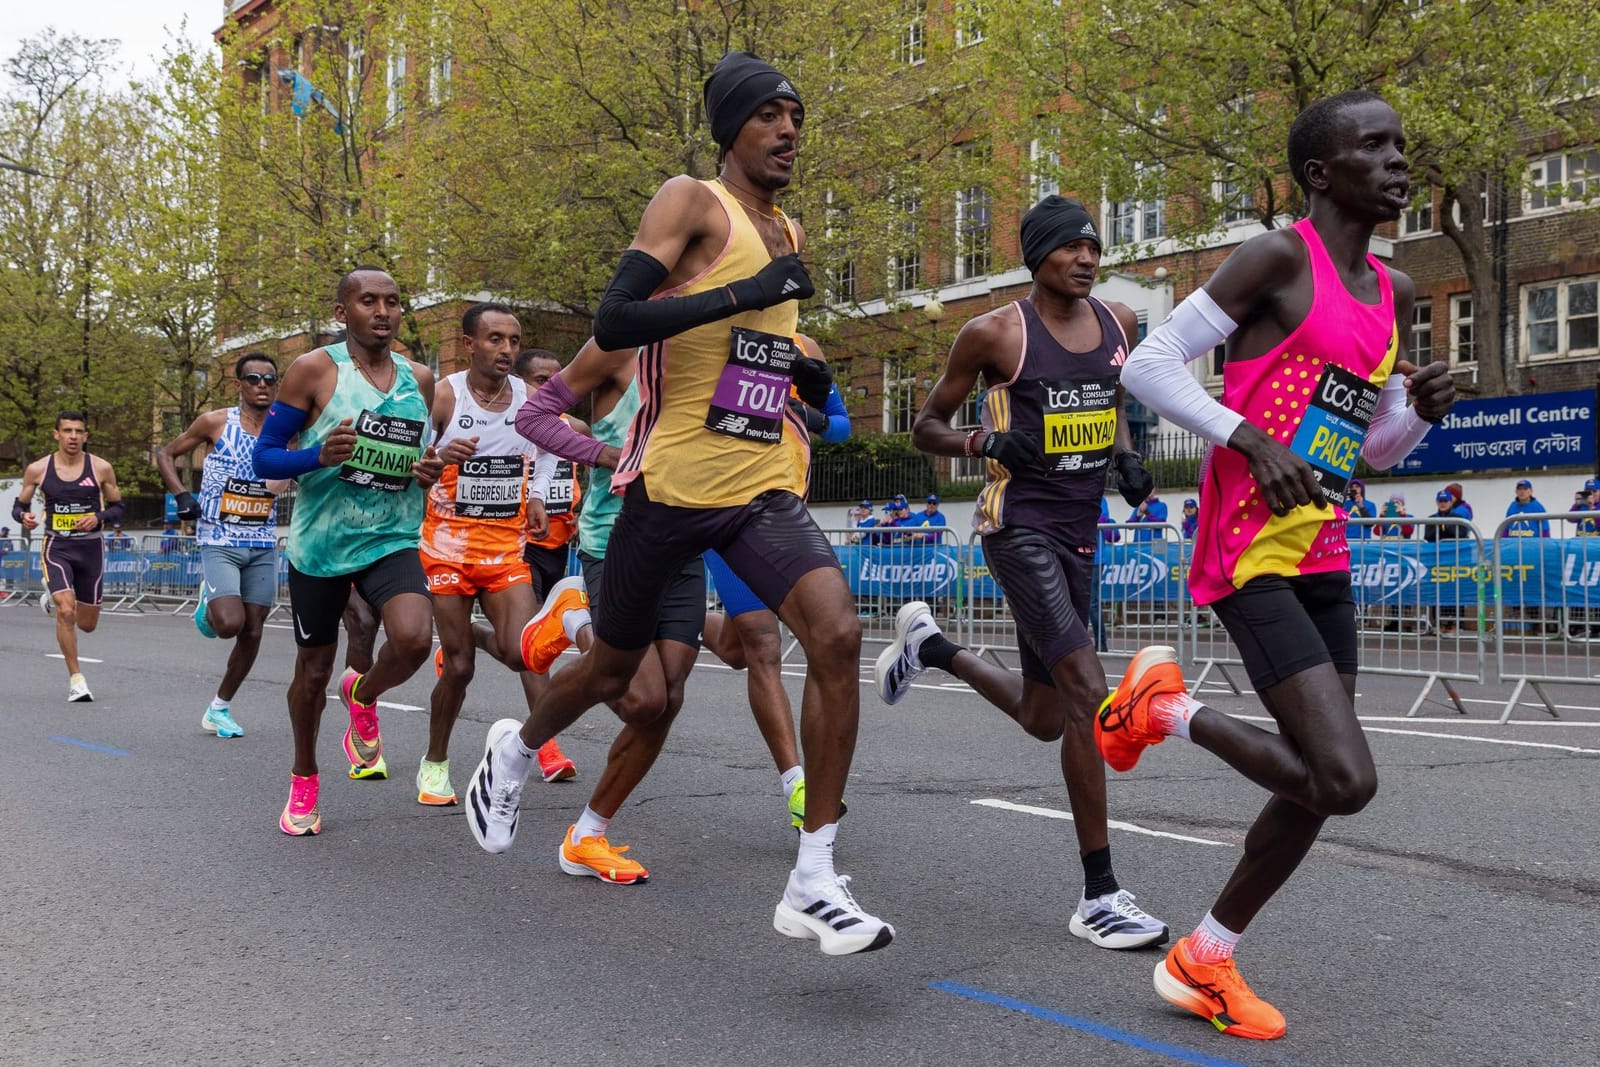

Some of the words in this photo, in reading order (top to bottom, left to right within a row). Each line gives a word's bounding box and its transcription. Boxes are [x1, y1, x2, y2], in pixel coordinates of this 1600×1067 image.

[736, 334, 769, 365] tcs
[772, 341, 790, 351] TATA
[737, 379, 787, 413] TOLA
[1081, 383, 1101, 391] TATA
[1321, 372, 1358, 413] tcs
[1361, 388, 1377, 402] TATA
[1048, 387, 1080, 408] tcs
[361, 414, 388, 437] tcs
[390, 420, 407, 429] TATA
[1440, 408, 1521, 430] Shadwell
[1526, 406, 1590, 424] Centre
[746, 428, 763, 437] new
[1051, 419, 1115, 448] MUNYAO
[1307, 425, 1361, 472] PACE
[1532, 431, 1582, 455] সেন্টার
[351, 445, 417, 473] ATANAW
[463, 460, 488, 474] tcs
[228, 480, 249, 494] tcs
[461, 483, 469, 499] L.
[470, 484, 520, 501] GEBRESILASE
[55, 503, 70, 513] tcs
[225, 498, 270, 514] WOLDE
[56, 518, 77, 529] CHA
[860, 557, 947, 582] Lucozade
[1430, 564, 1534, 583] SPORT
[427, 572, 460, 587] NEOS
